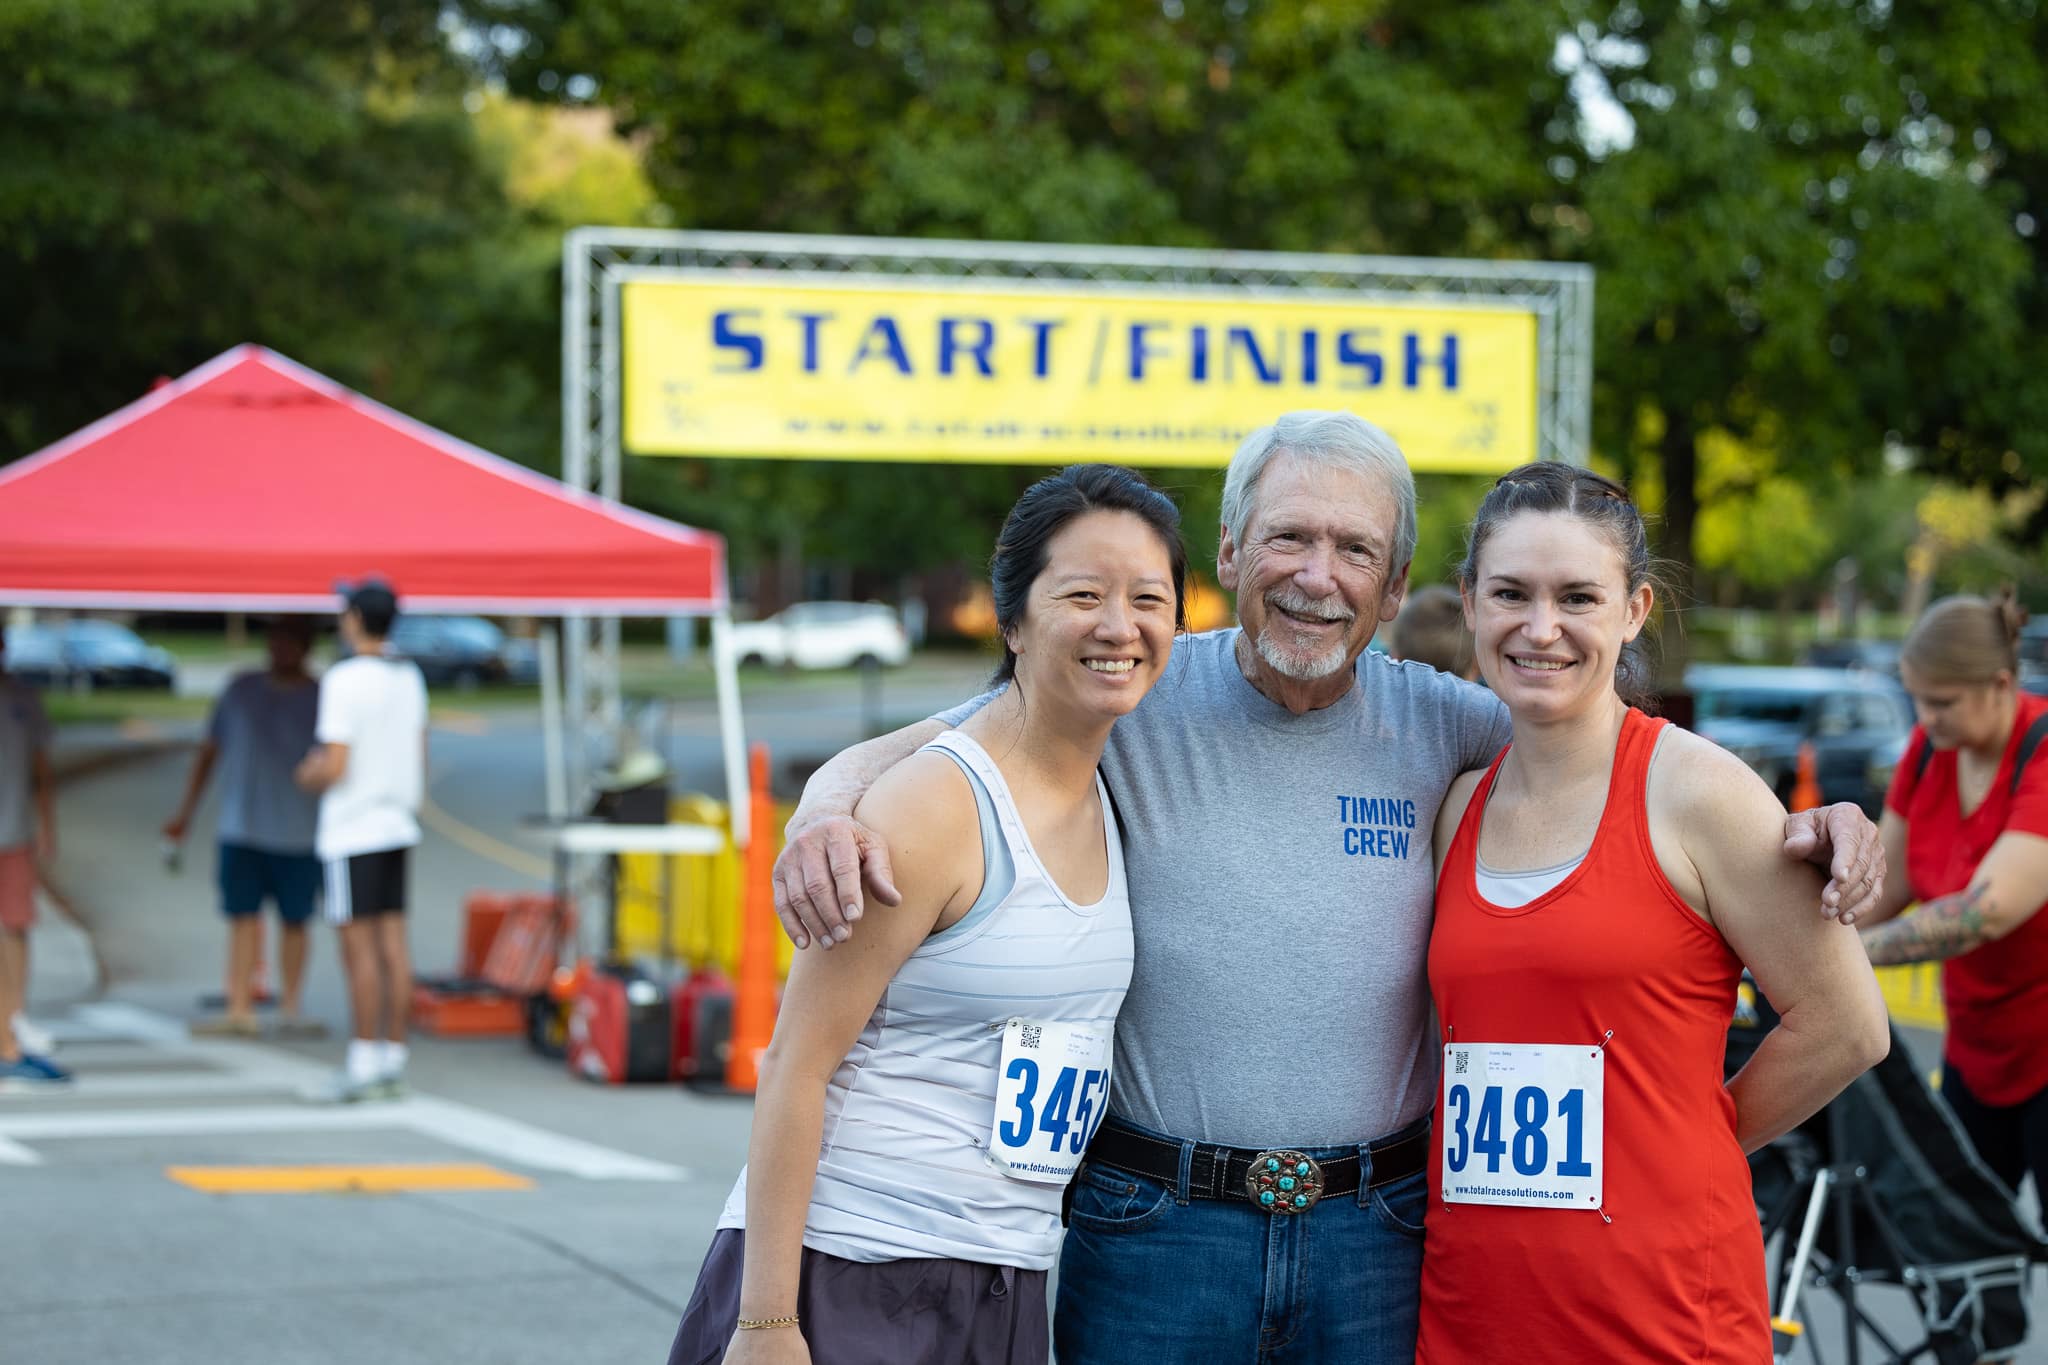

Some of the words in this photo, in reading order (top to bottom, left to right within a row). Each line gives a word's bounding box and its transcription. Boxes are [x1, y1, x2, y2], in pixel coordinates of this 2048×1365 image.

[1336, 795, 1416, 829] TIMING
[1344, 827, 1410, 860] CREW
[1447, 1083, 1592, 1178] 3481
[1455, 1184, 1574, 1200] www.totalracesolutions.com
